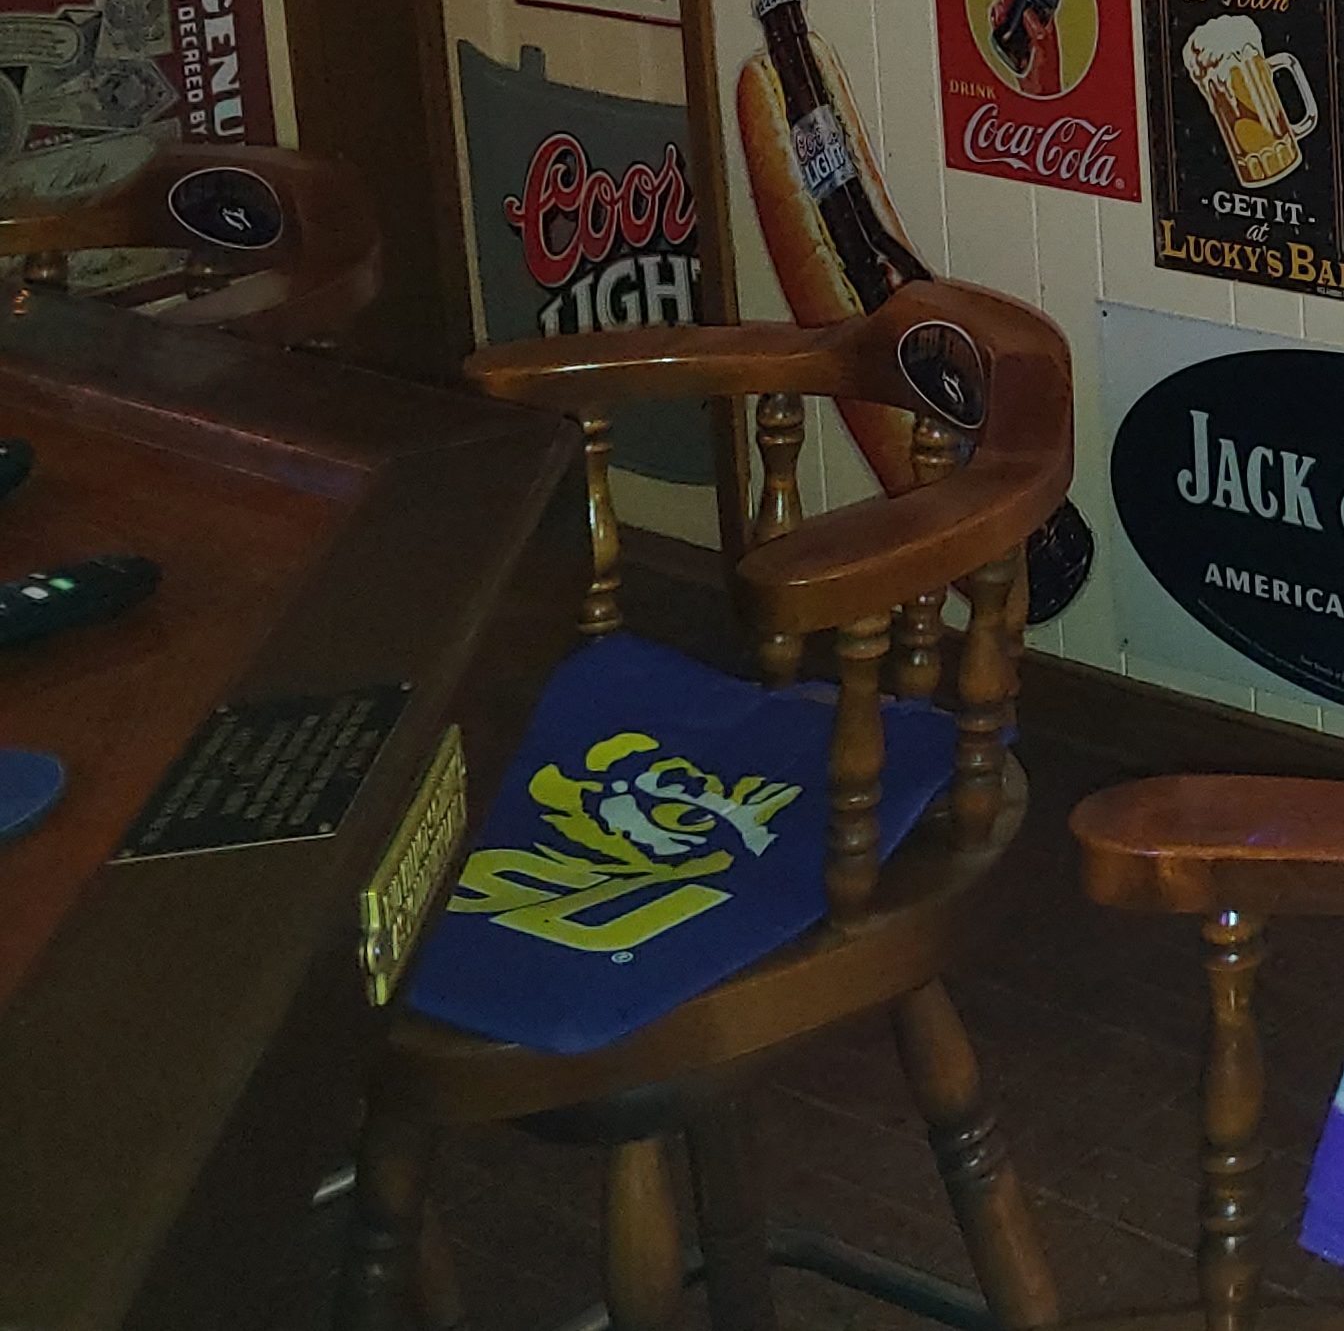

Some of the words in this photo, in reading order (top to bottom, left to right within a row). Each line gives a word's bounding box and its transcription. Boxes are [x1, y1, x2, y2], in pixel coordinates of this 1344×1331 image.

[178, 7, 203, 96] DECREED
[964, 104, 1122, 187] Coca-Cola
[1160, 218, 1284, 279] LUCKY'S
[1177, 409, 1324, 533] JACK
